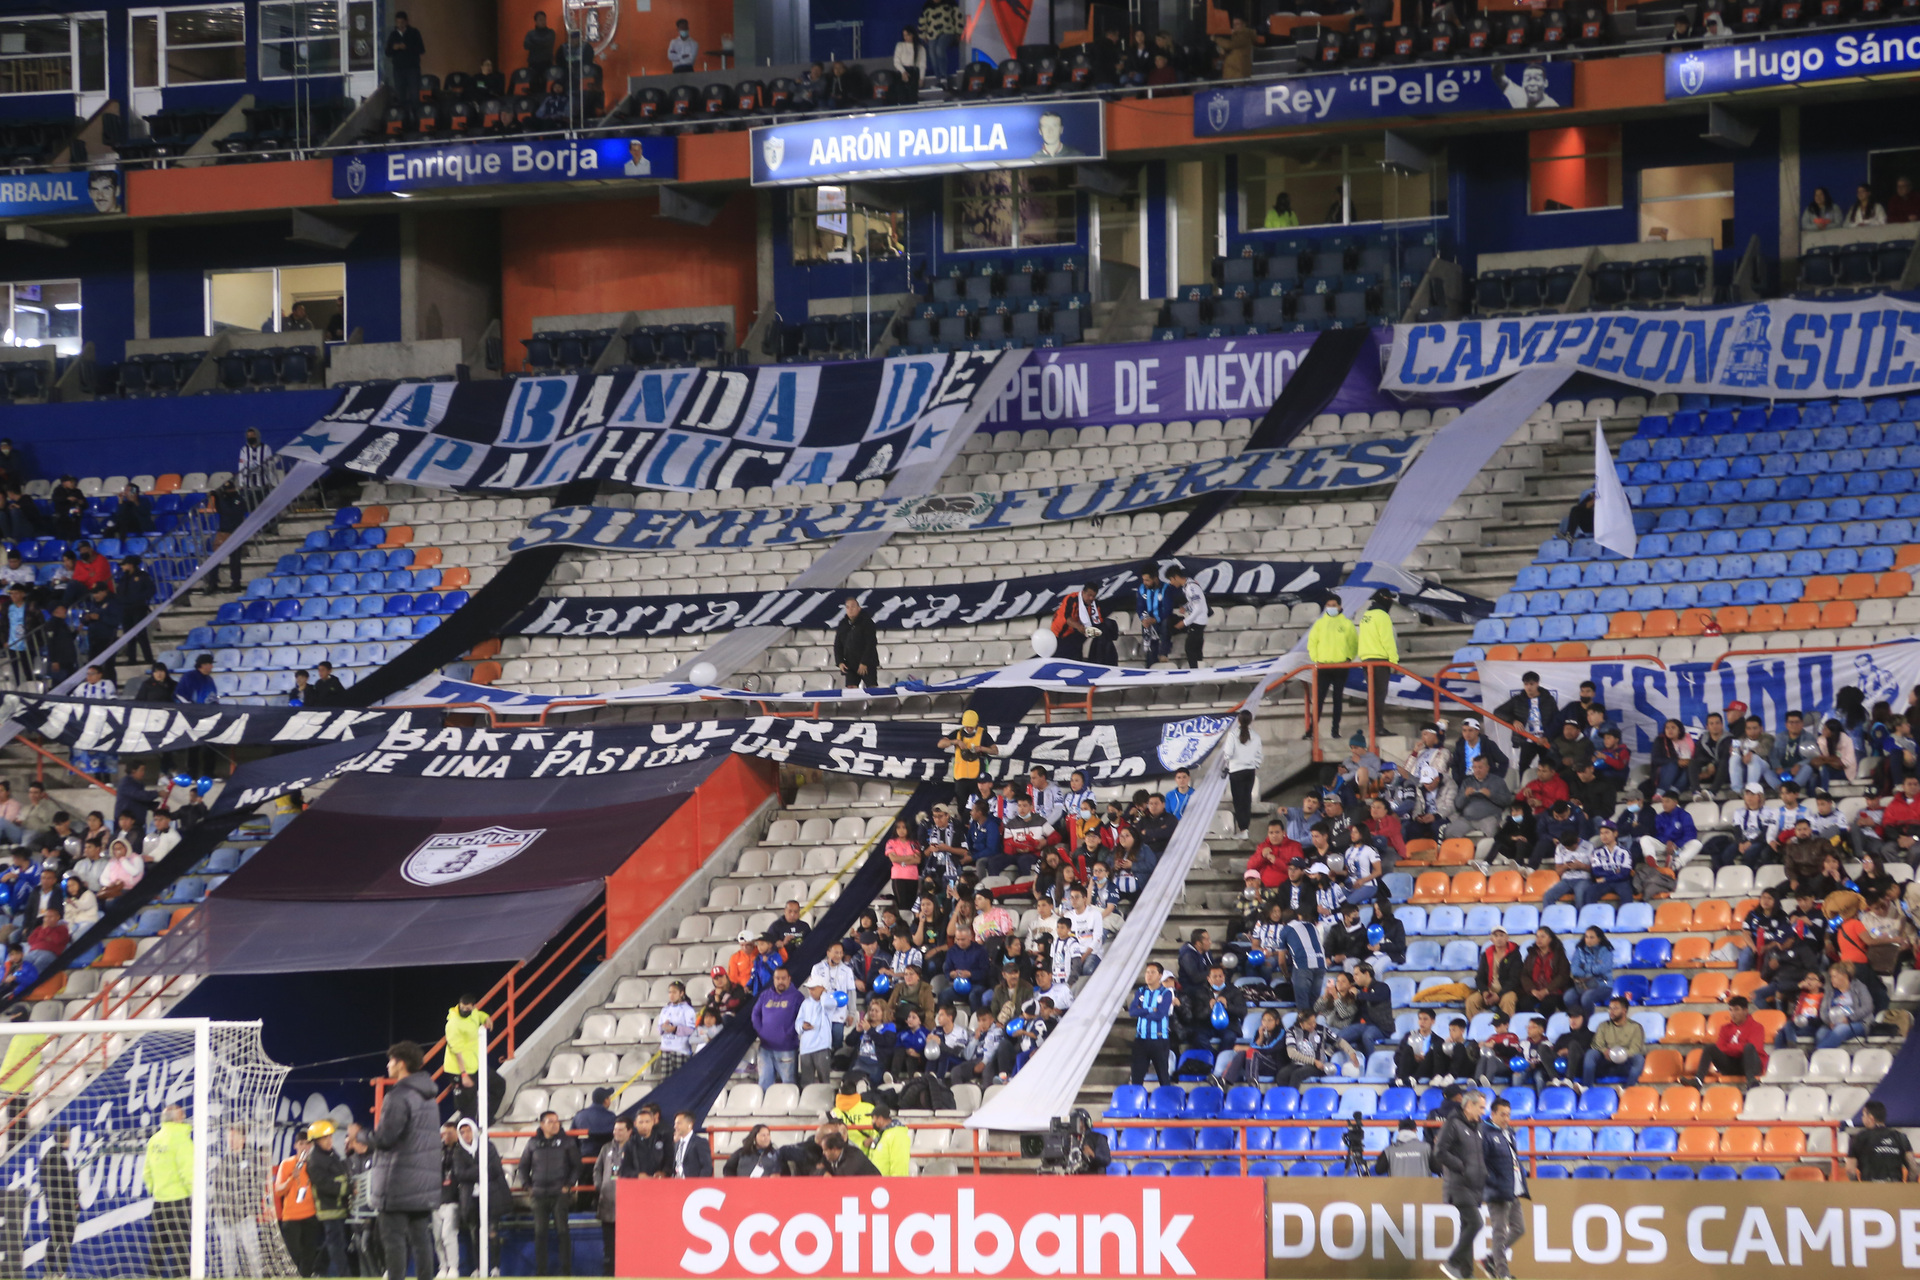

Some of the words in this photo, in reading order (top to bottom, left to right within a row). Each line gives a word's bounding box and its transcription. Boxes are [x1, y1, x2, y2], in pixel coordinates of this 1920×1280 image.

[1734, 46, 1824, 83] Hugo
[1835, 33, 1920, 68] Sánc
[1265, 85, 1336, 118] Rey
[387, 149, 500, 182] Enrique
[511, 143, 598, 176] Borja
[808, 127, 891, 166] AARÓN
[898, 123, 1008, 158] PADILLA
[0, 181, 78, 203] RBAJAL
[1400, 316, 1735, 384] CAMPEON
[324, 384, 434, 428] LA
[501, 370, 798, 444] BANDA
[874, 349, 1001, 434] DE
[982, 352, 1089, 423] PEÓN
[1115, 358, 1160, 416] DE
[1185, 341, 1309, 412] MÉXIC
[407, 430, 833, 490] PACHUCA
[508, 497, 897, 550] SIEMPRE
[968, 436, 1420, 529] FUERTES
[421, 754, 511, 778] UNA
[730, 733, 797, 762] UN
[434, 831, 527, 847] PACHUCA
[679, 1186, 1197, 1277] Scotiabank
[1272, 1201, 1513, 1262] DONDE
[1533, 1204, 1668, 1265] LOS
[1686, 1205, 1920, 1268] CAMPE
